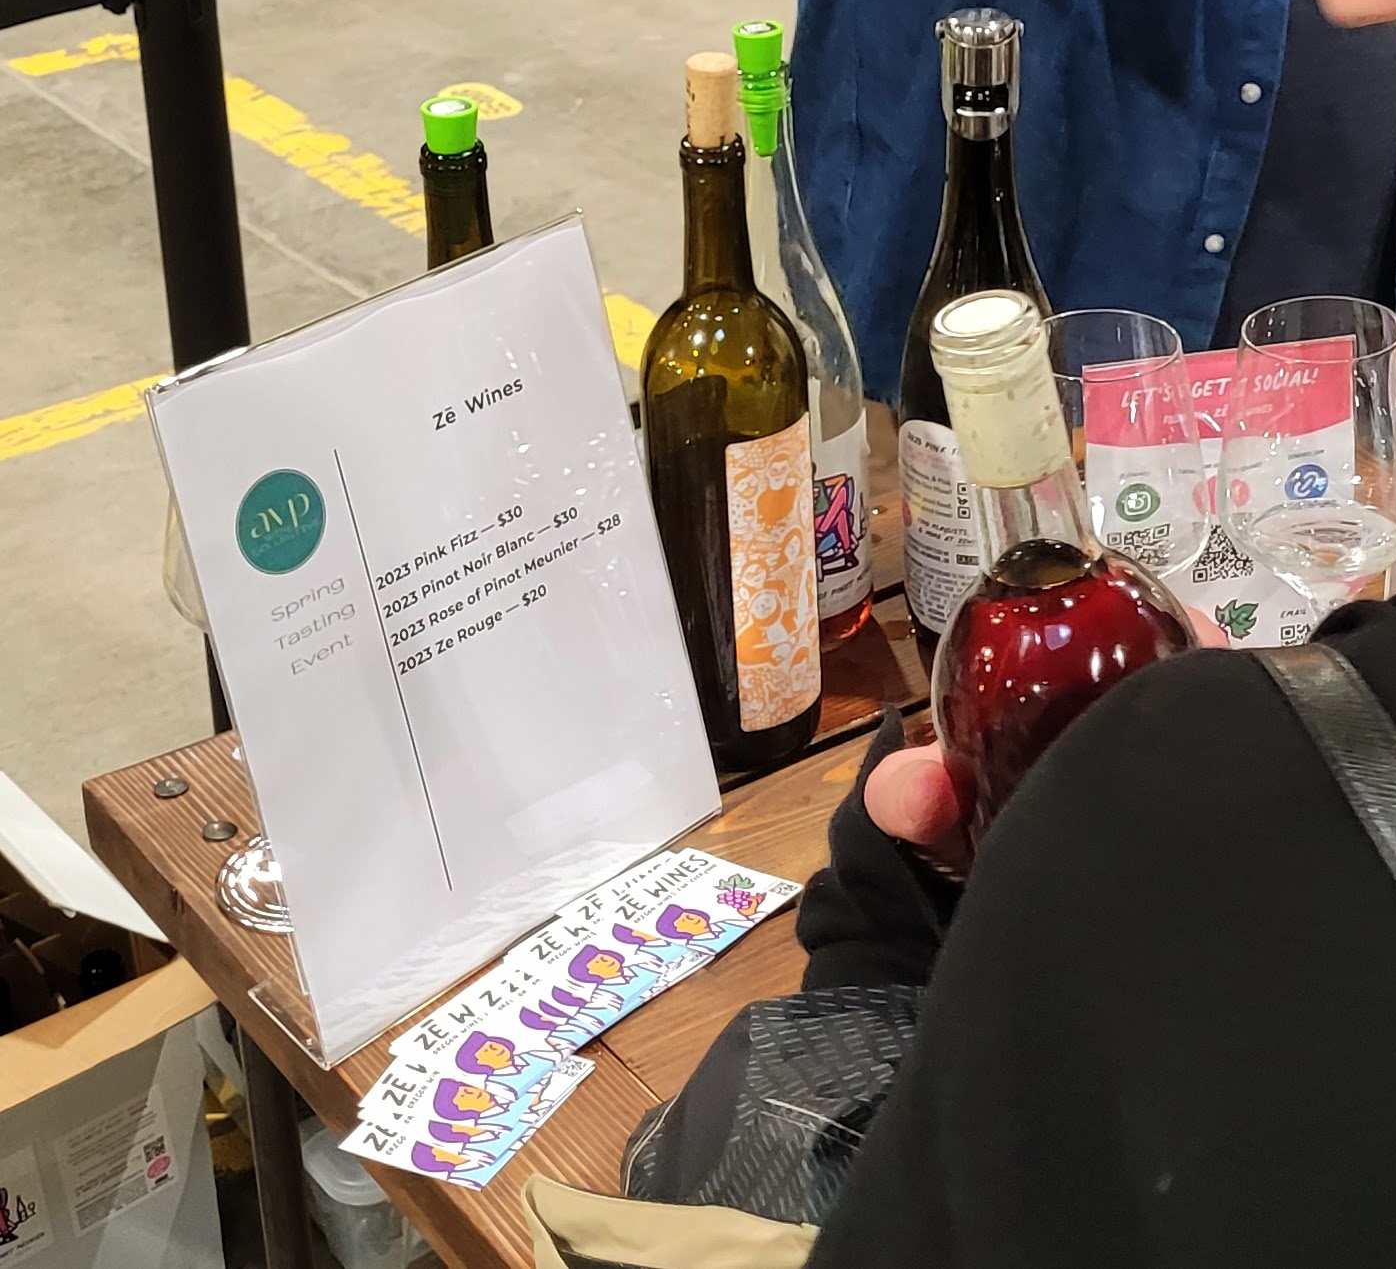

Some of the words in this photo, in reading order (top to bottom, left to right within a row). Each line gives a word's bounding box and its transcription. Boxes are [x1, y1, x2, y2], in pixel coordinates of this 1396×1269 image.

[464, 377, 524, 414] Wines
[1121, 386, 1172, 408] LET'S
[1191, 377, 1232, 399] GET
[1253, 367, 1319, 392] SOCIAL!
[375, 562, 412, 591] 2023
[413, 545, 448, 571] Pink
[450, 529, 480, 553] Fizz
[497, 505, 523, 528] $30
[382, 590, 419, 619] 2023
[420, 569, 461, 599] Pinot
[462, 552, 493, 577] Noir
[495, 531, 536, 559] Blanc
[552, 506, 578, 529] $30
[271, 577, 345, 622] Spring
[390, 618, 426, 647] 2023
[428, 600, 464, 627] Rose
[466, 587, 482, 606] of
[484, 568, 523, 597] Pinot
[523, 537, 580, 576] Meunier
[597, 513, 622, 536] $28
[274, 603, 356, 651] Tasting
[397, 646, 434, 675] 2023
[434, 637, 455, 656] Ze
[456, 610, 504, 643] Rouge
[521, 584, 548, 608] $20
[290, 634, 355, 676] Event
[642, 853, 710, 899] WINES
